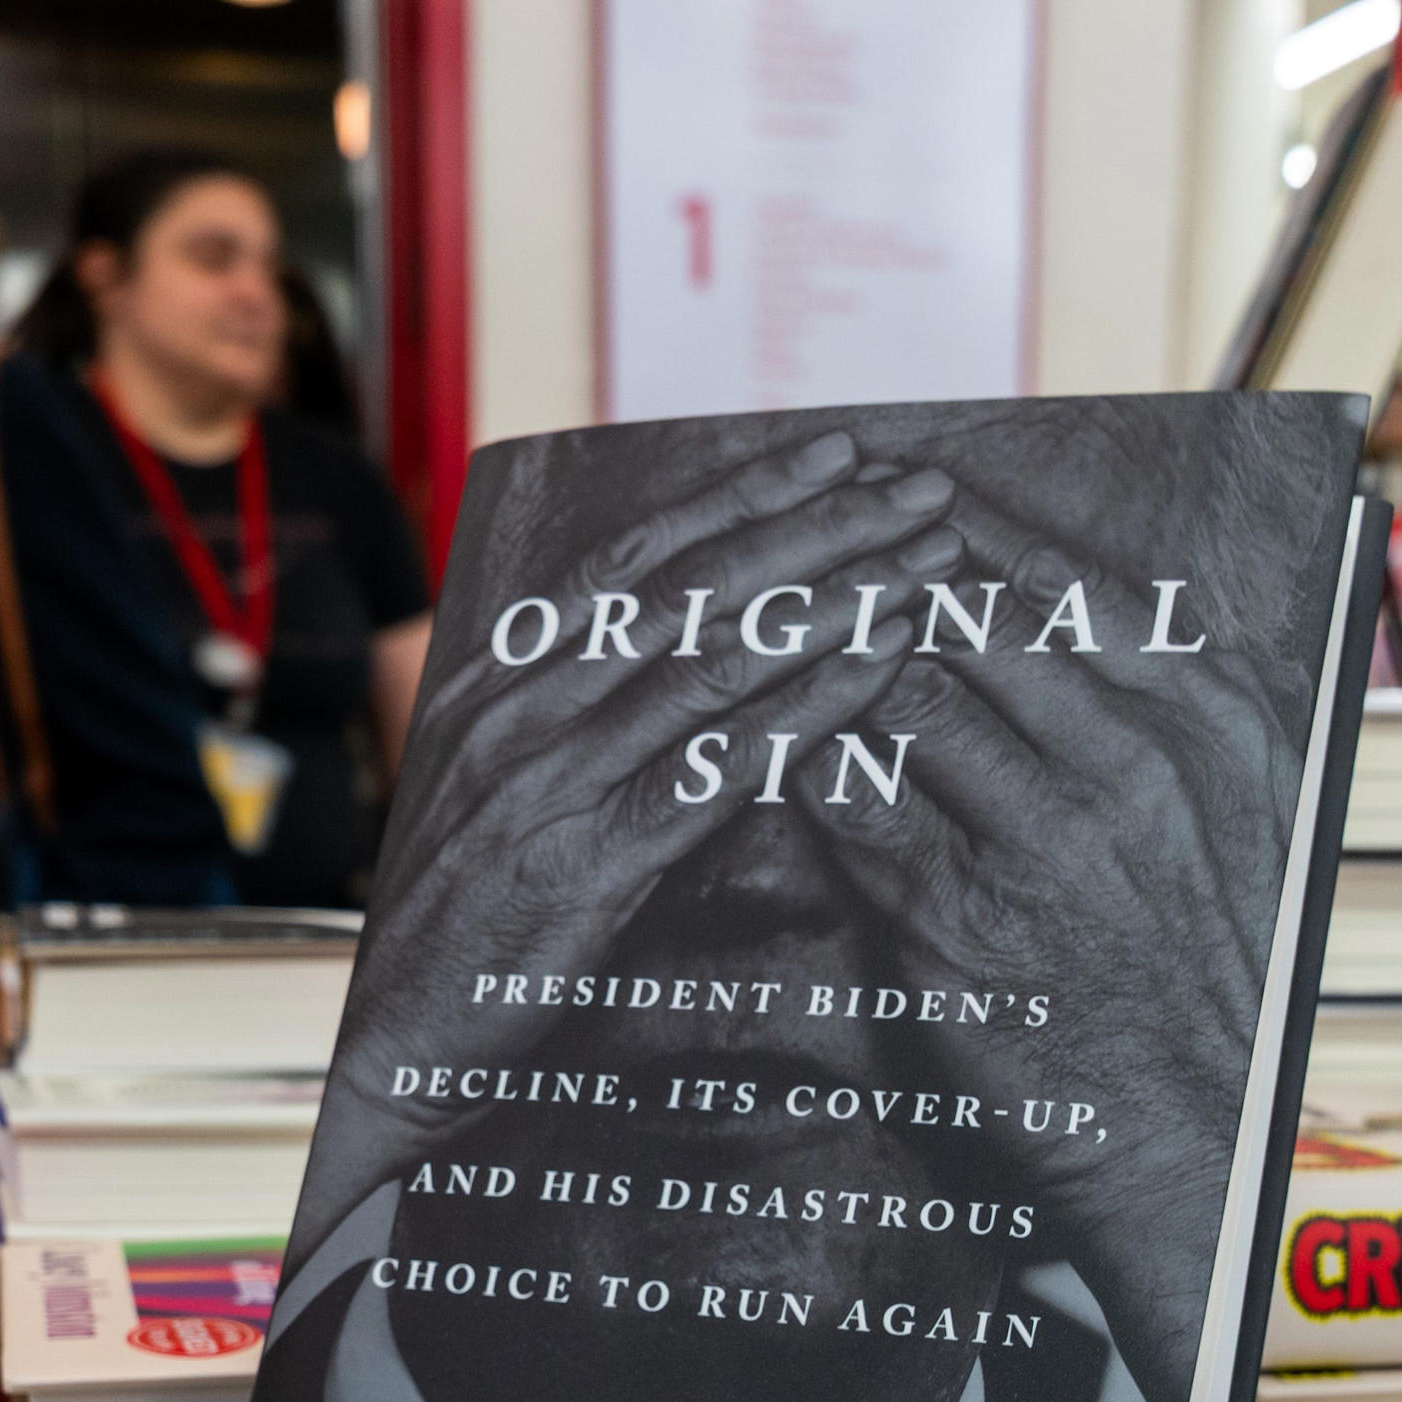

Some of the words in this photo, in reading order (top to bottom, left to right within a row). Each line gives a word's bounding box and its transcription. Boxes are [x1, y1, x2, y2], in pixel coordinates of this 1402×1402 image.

[490, 578, 1208, 667] ORIGINAL
[673, 731, 918, 807] SIN
[472, 973, 783, 1016] PRESIDENT
[805, 984, 1053, 1028] BIDEN'S
[391, 1066, 640, 1113] DECLINE,
[667, 1078, 758, 1114] ITS
[785, 1085, 1109, 1145] COVER-UP,
[408, 1162, 519, 1198] AND
[541, 1170, 633, 1207] HIS
[658, 1178, 1035, 1239] DISASTROUS
[371, 1257, 573, 1303] CHOICE
[599, 1274, 670, 1312] TO
[697, 1285, 815, 1327] RUN
[838, 1299, 1042, 1349] AGAIN
